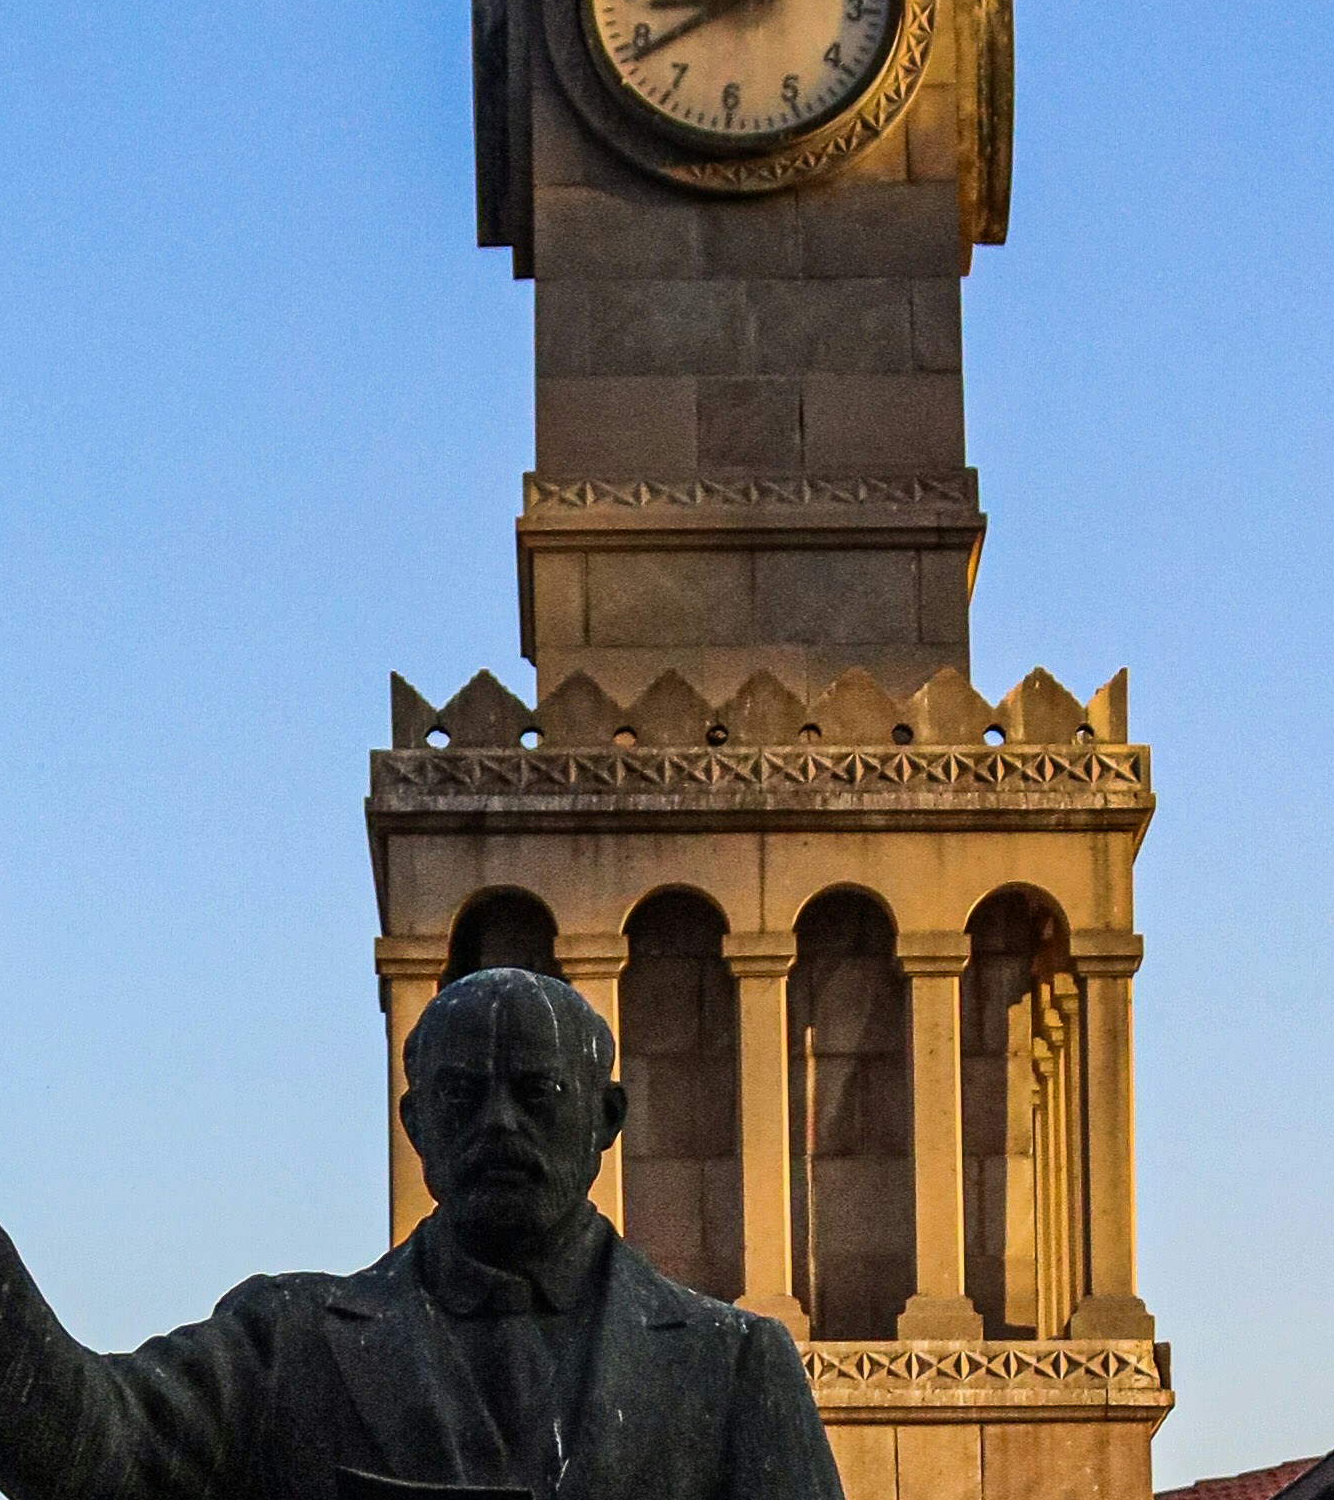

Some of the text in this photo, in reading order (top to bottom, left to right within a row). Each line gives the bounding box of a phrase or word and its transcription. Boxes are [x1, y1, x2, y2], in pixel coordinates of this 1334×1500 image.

[632, 22, 652, 51] 8
[823, 41, 845, 68] 4
[671, 61, 690, 91] 7
[780, 74, 801, 103] 5
[721, 82, 741, 110] 6
